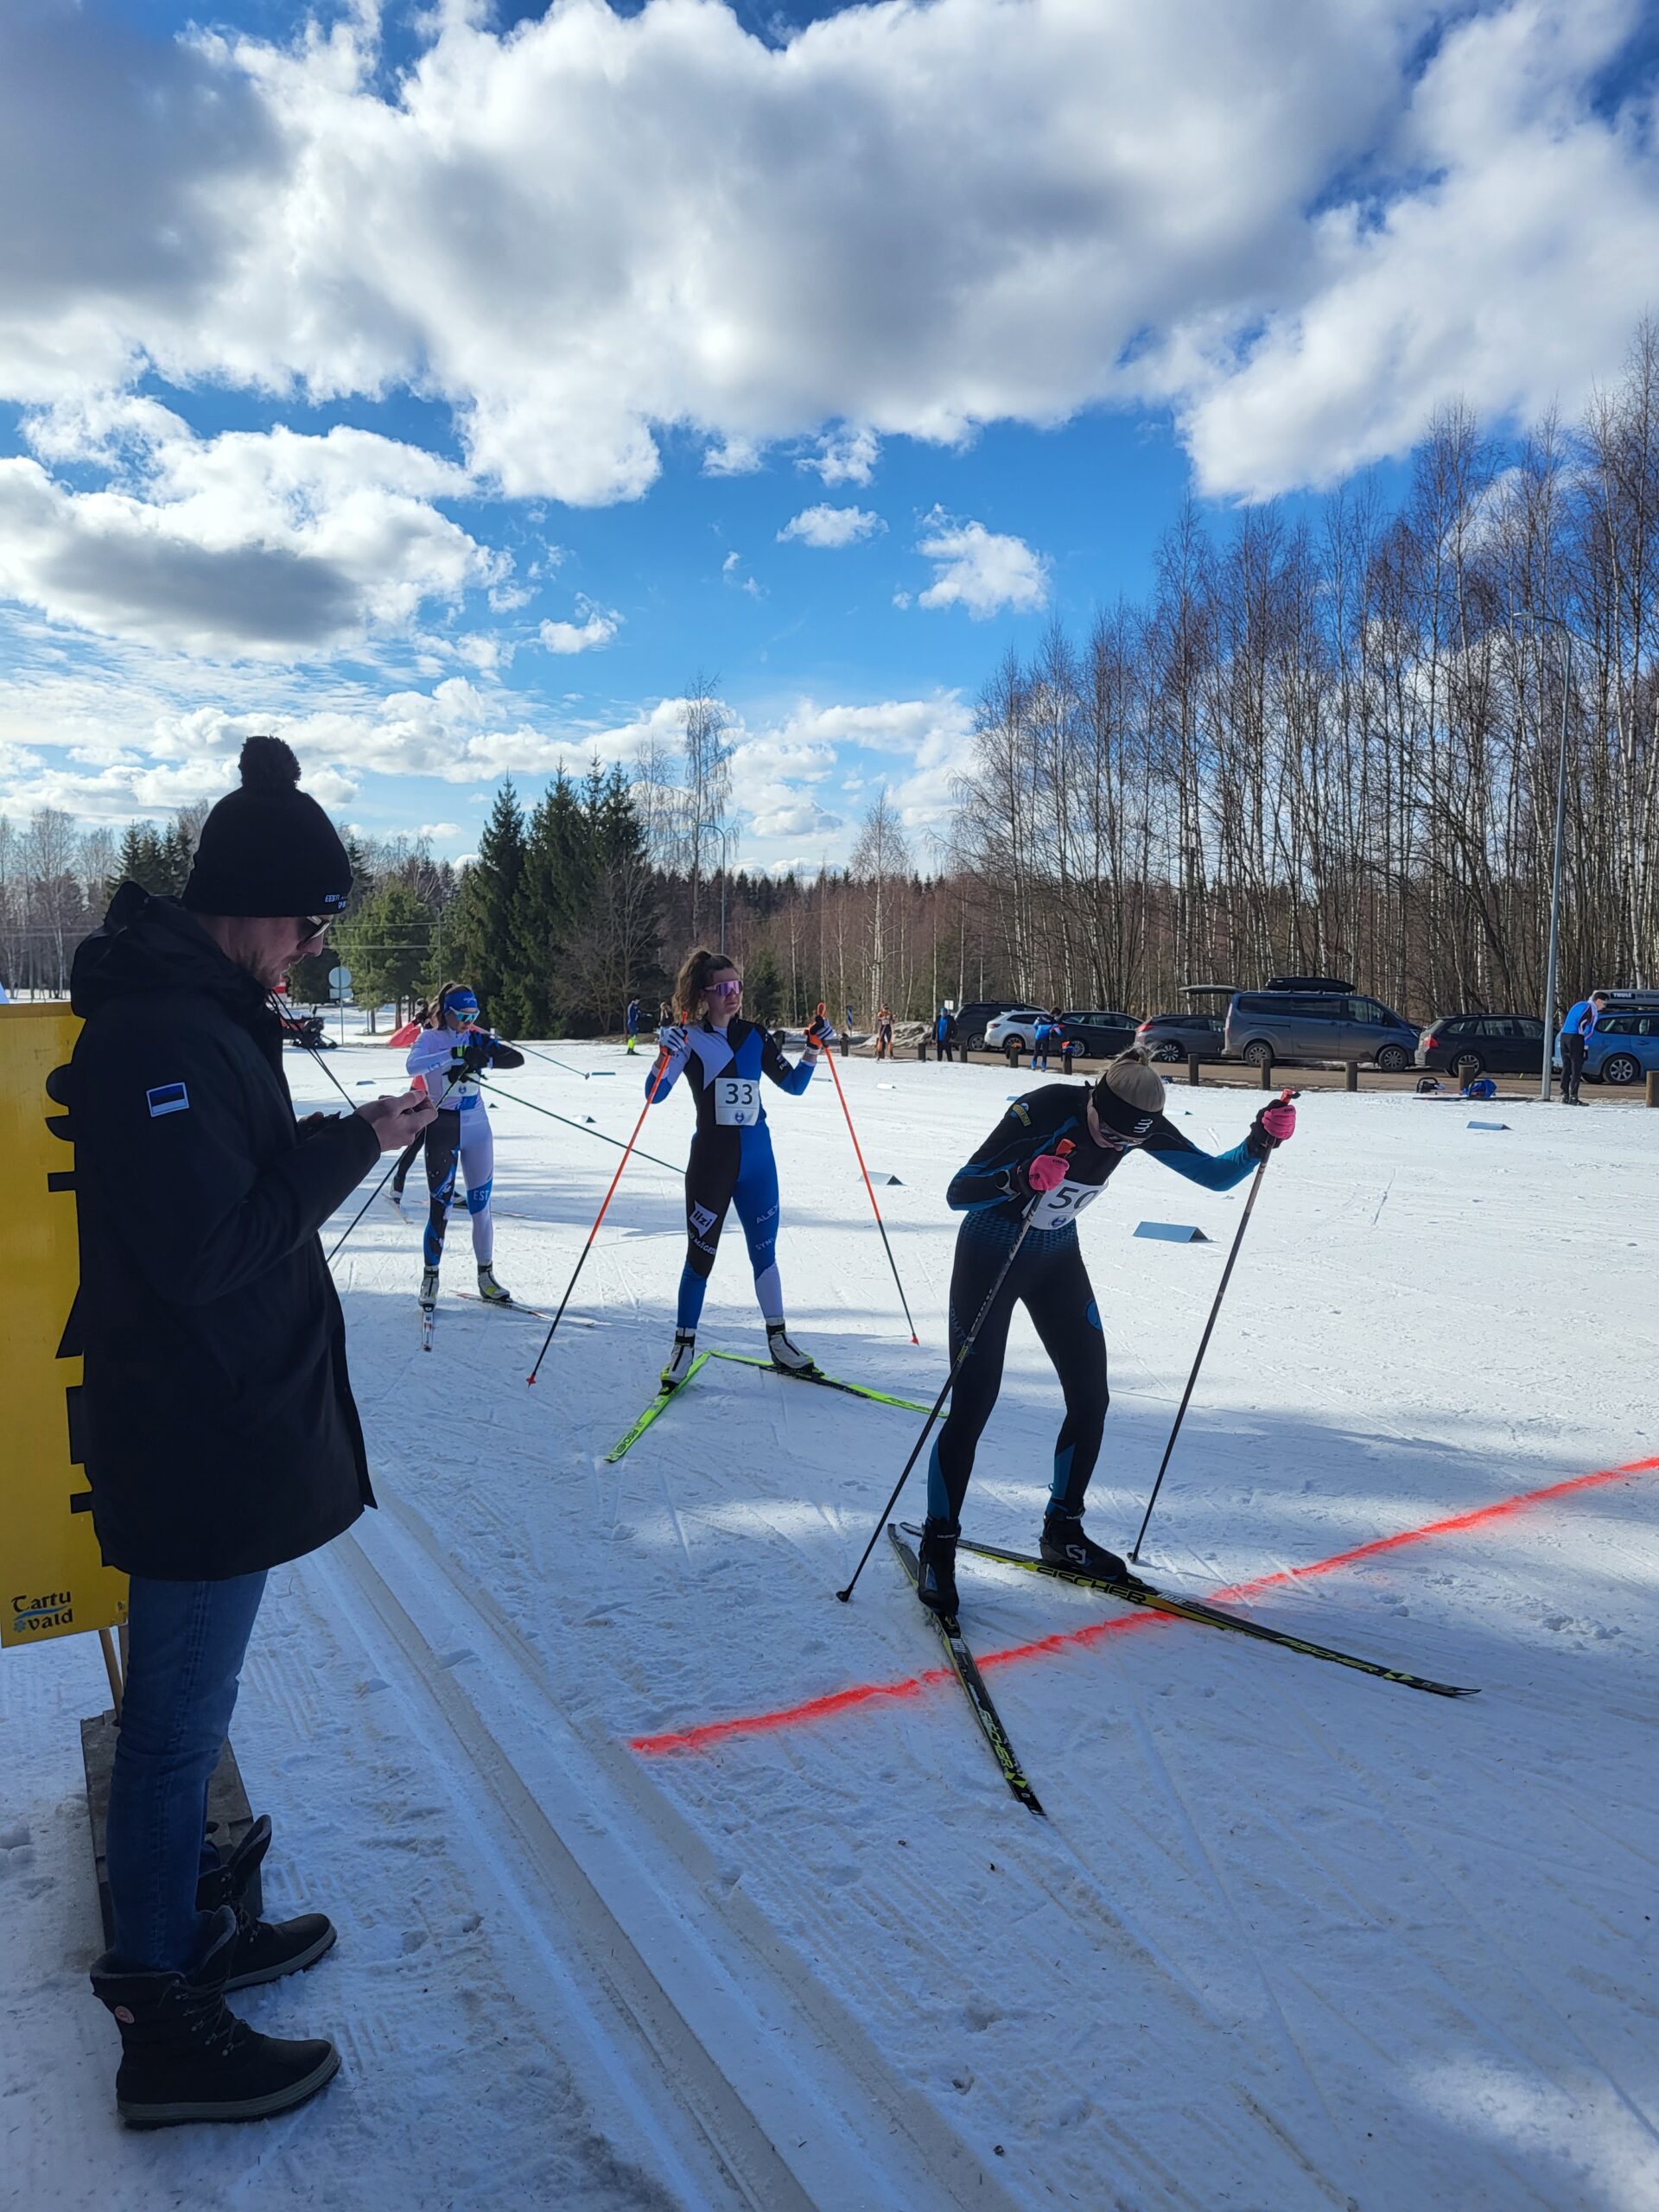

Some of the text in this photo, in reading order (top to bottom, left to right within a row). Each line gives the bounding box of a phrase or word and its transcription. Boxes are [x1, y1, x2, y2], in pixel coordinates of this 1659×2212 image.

[725, 1083, 753, 1105] 33
[474, 1189, 490, 1201] EST
[1047, 1186, 1099, 1210] 50
[1037, 1566, 1147, 1604] FISCHER
[11, 1591, 72, 1613] Tartu
[28, 1609, 73, 1631] vald
[1275, 1637, 1380, 1673] FISCHER
